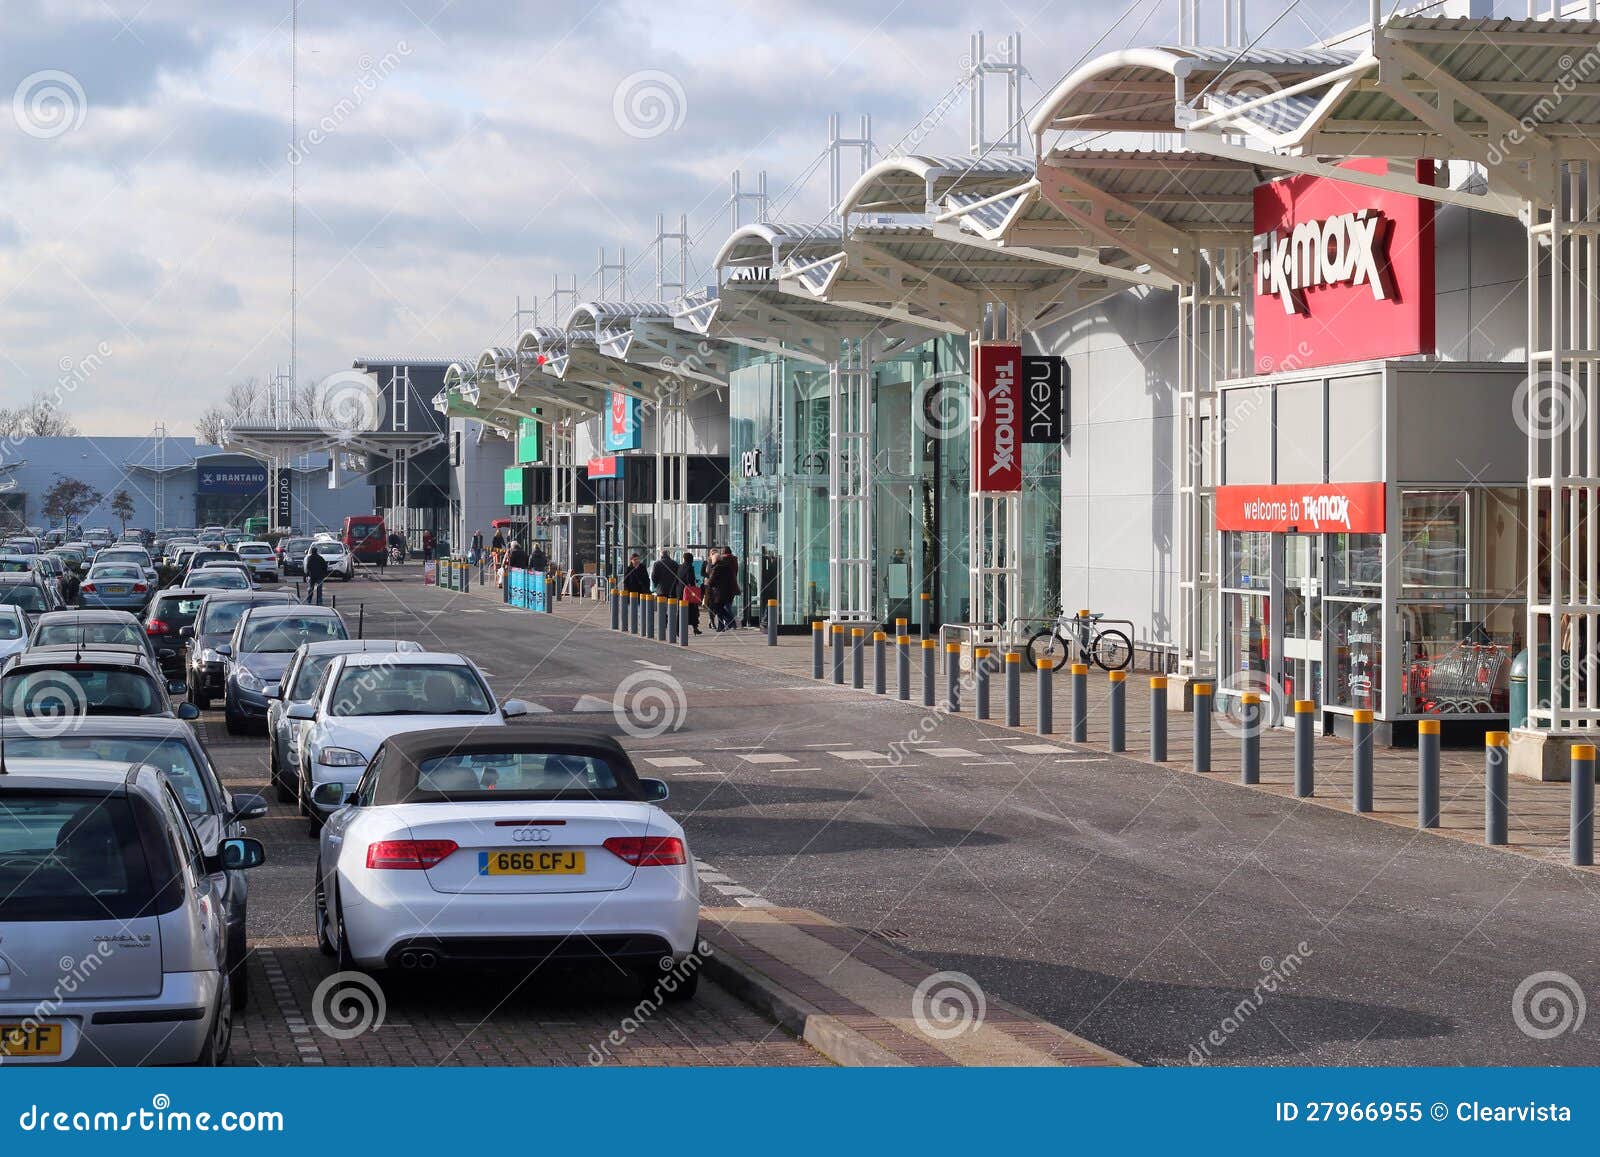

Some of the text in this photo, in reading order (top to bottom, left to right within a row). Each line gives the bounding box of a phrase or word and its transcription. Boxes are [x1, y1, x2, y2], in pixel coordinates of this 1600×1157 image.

[1030, 361, 1053, 437] next
[216, 473, 264, 482] BRANTANO
[279, 478, 289, 517] OUTFIT
[1243, 496, 1287, 520] welcome
[1289, 498, 1300, 521] to
[498, 852, 576, 870] 666 CFJ
